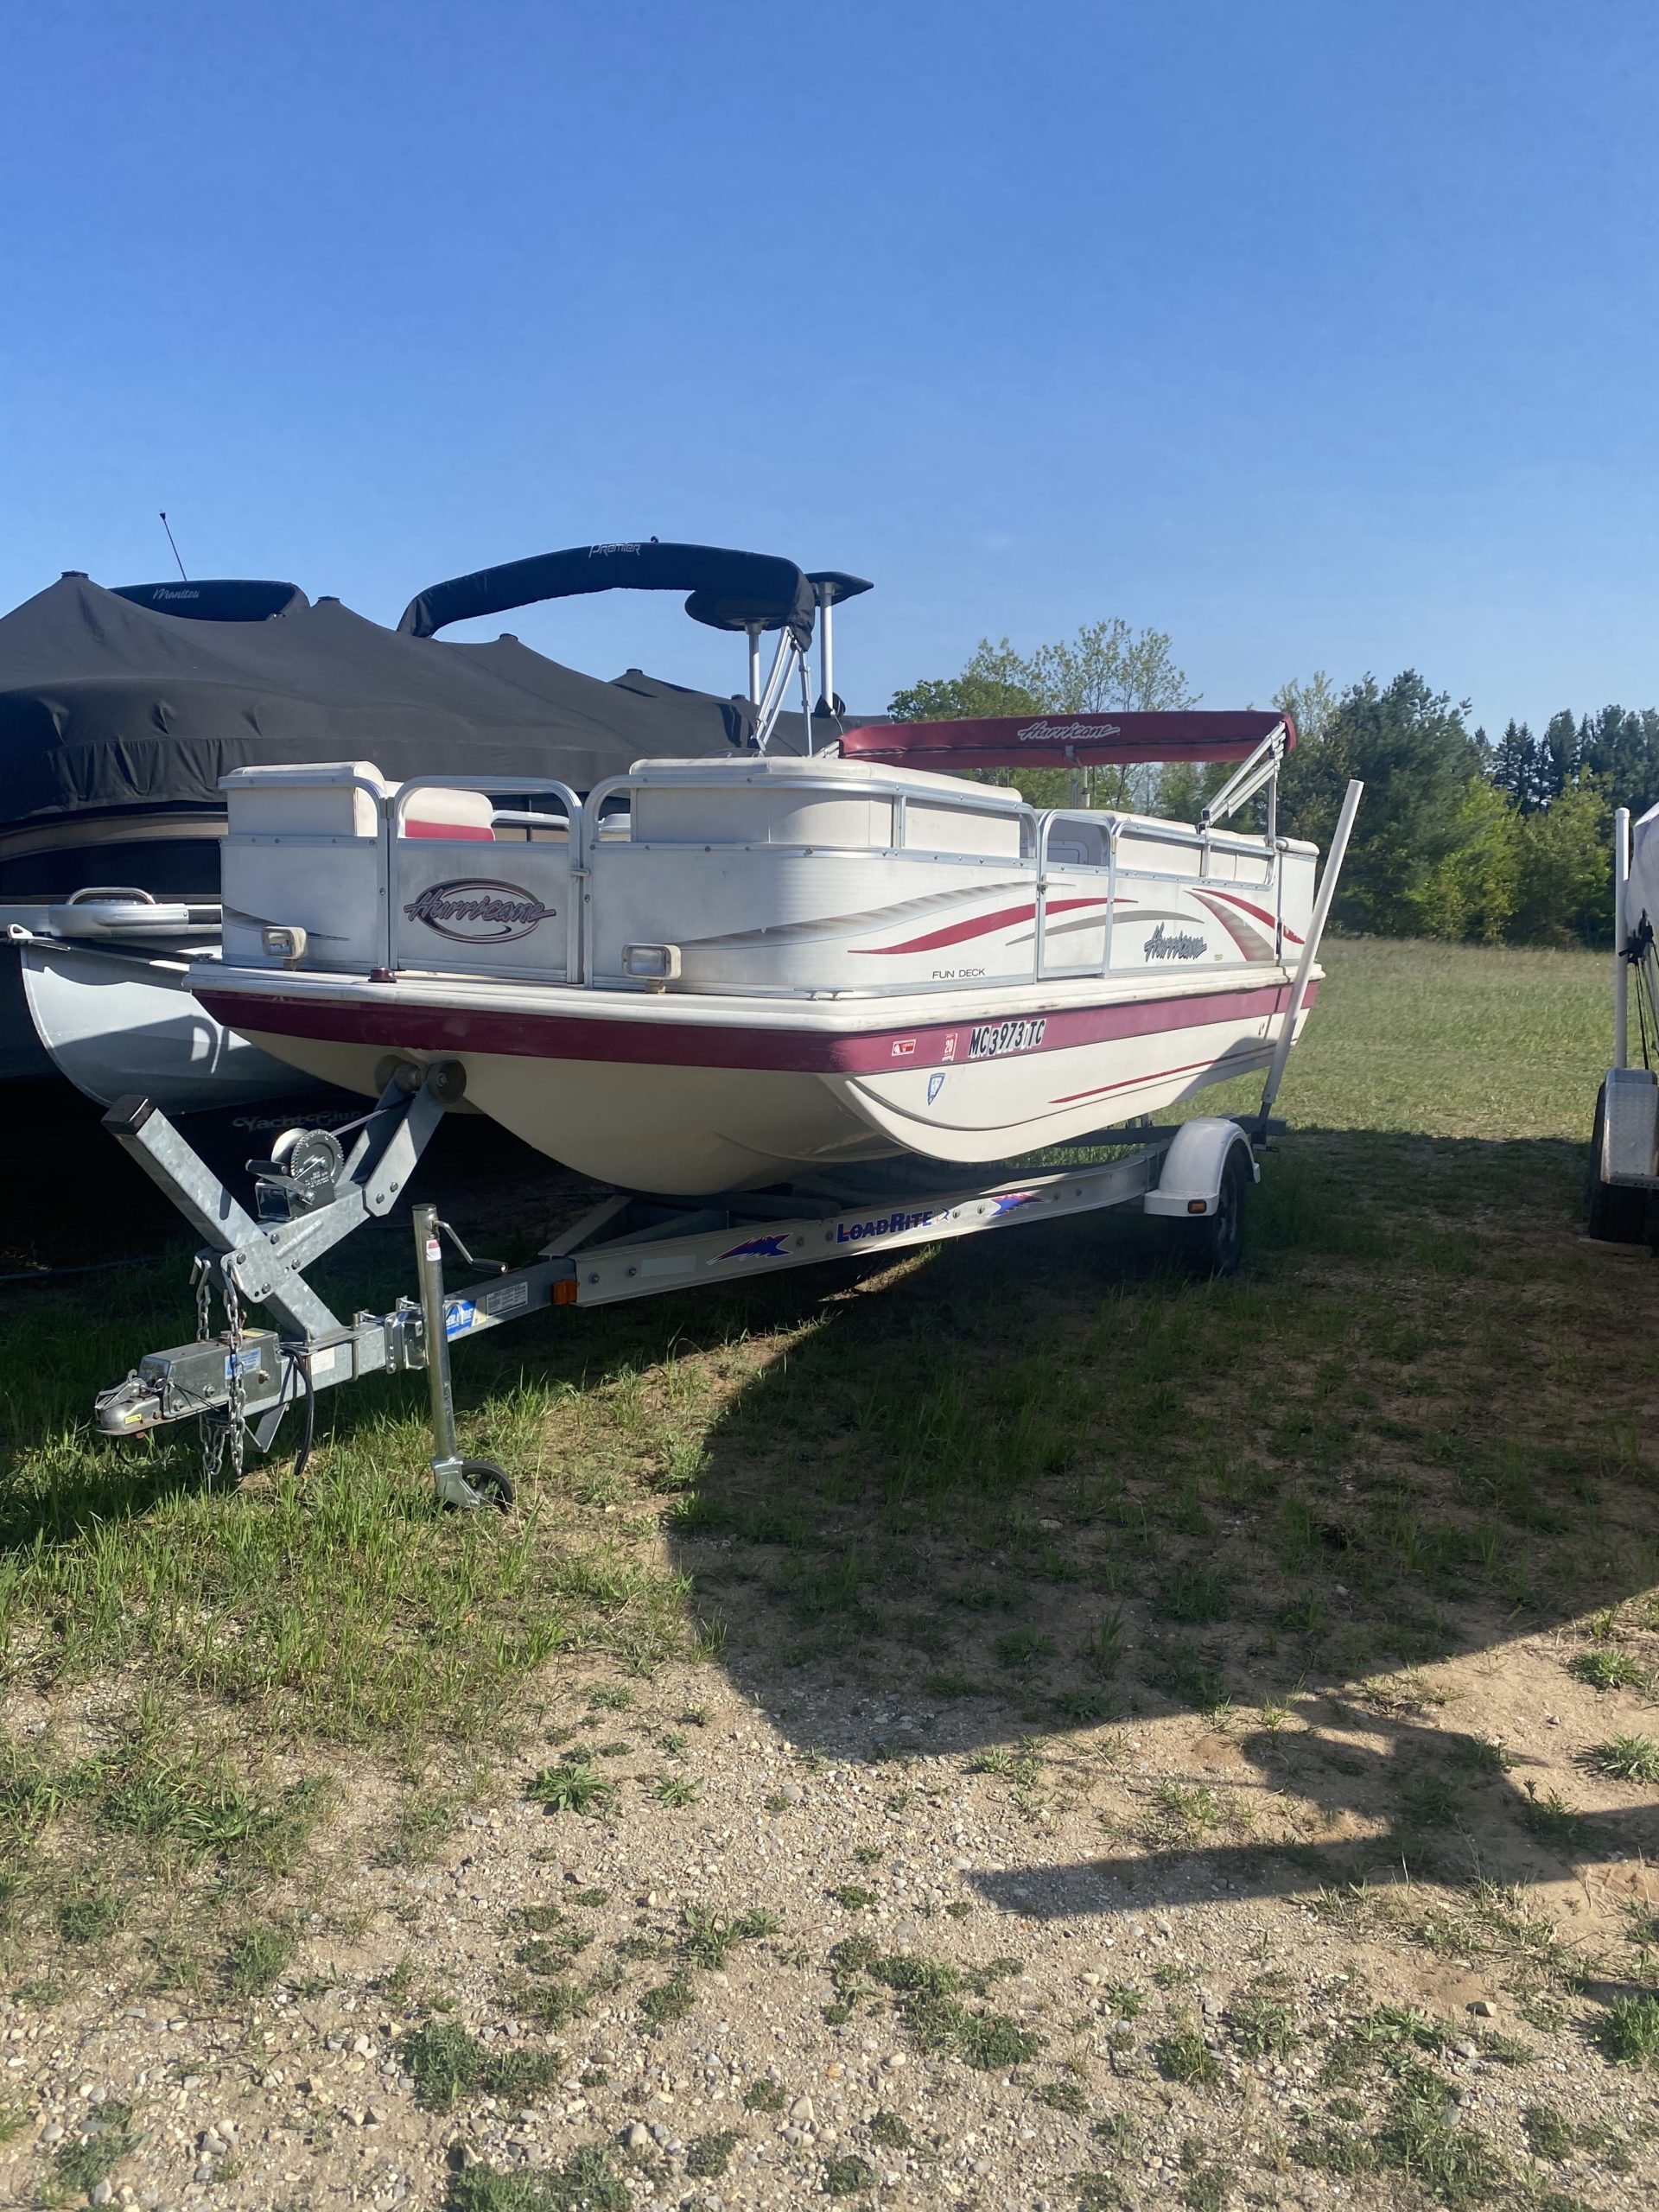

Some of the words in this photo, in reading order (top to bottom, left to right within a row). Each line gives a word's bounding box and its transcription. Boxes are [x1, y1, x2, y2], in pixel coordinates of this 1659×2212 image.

[153, 588, 200, 600] Manitou
[1017, 720, 1121, 741] Hurricane
[404, 888, 556, 924] Hurricane
[1144, 921, 1207, 963] Hurricane
[932, 970, 955, 979] FUN
[958, 968, 985, 978] DECK
[232, 1113, 304, 1133] Yacht
